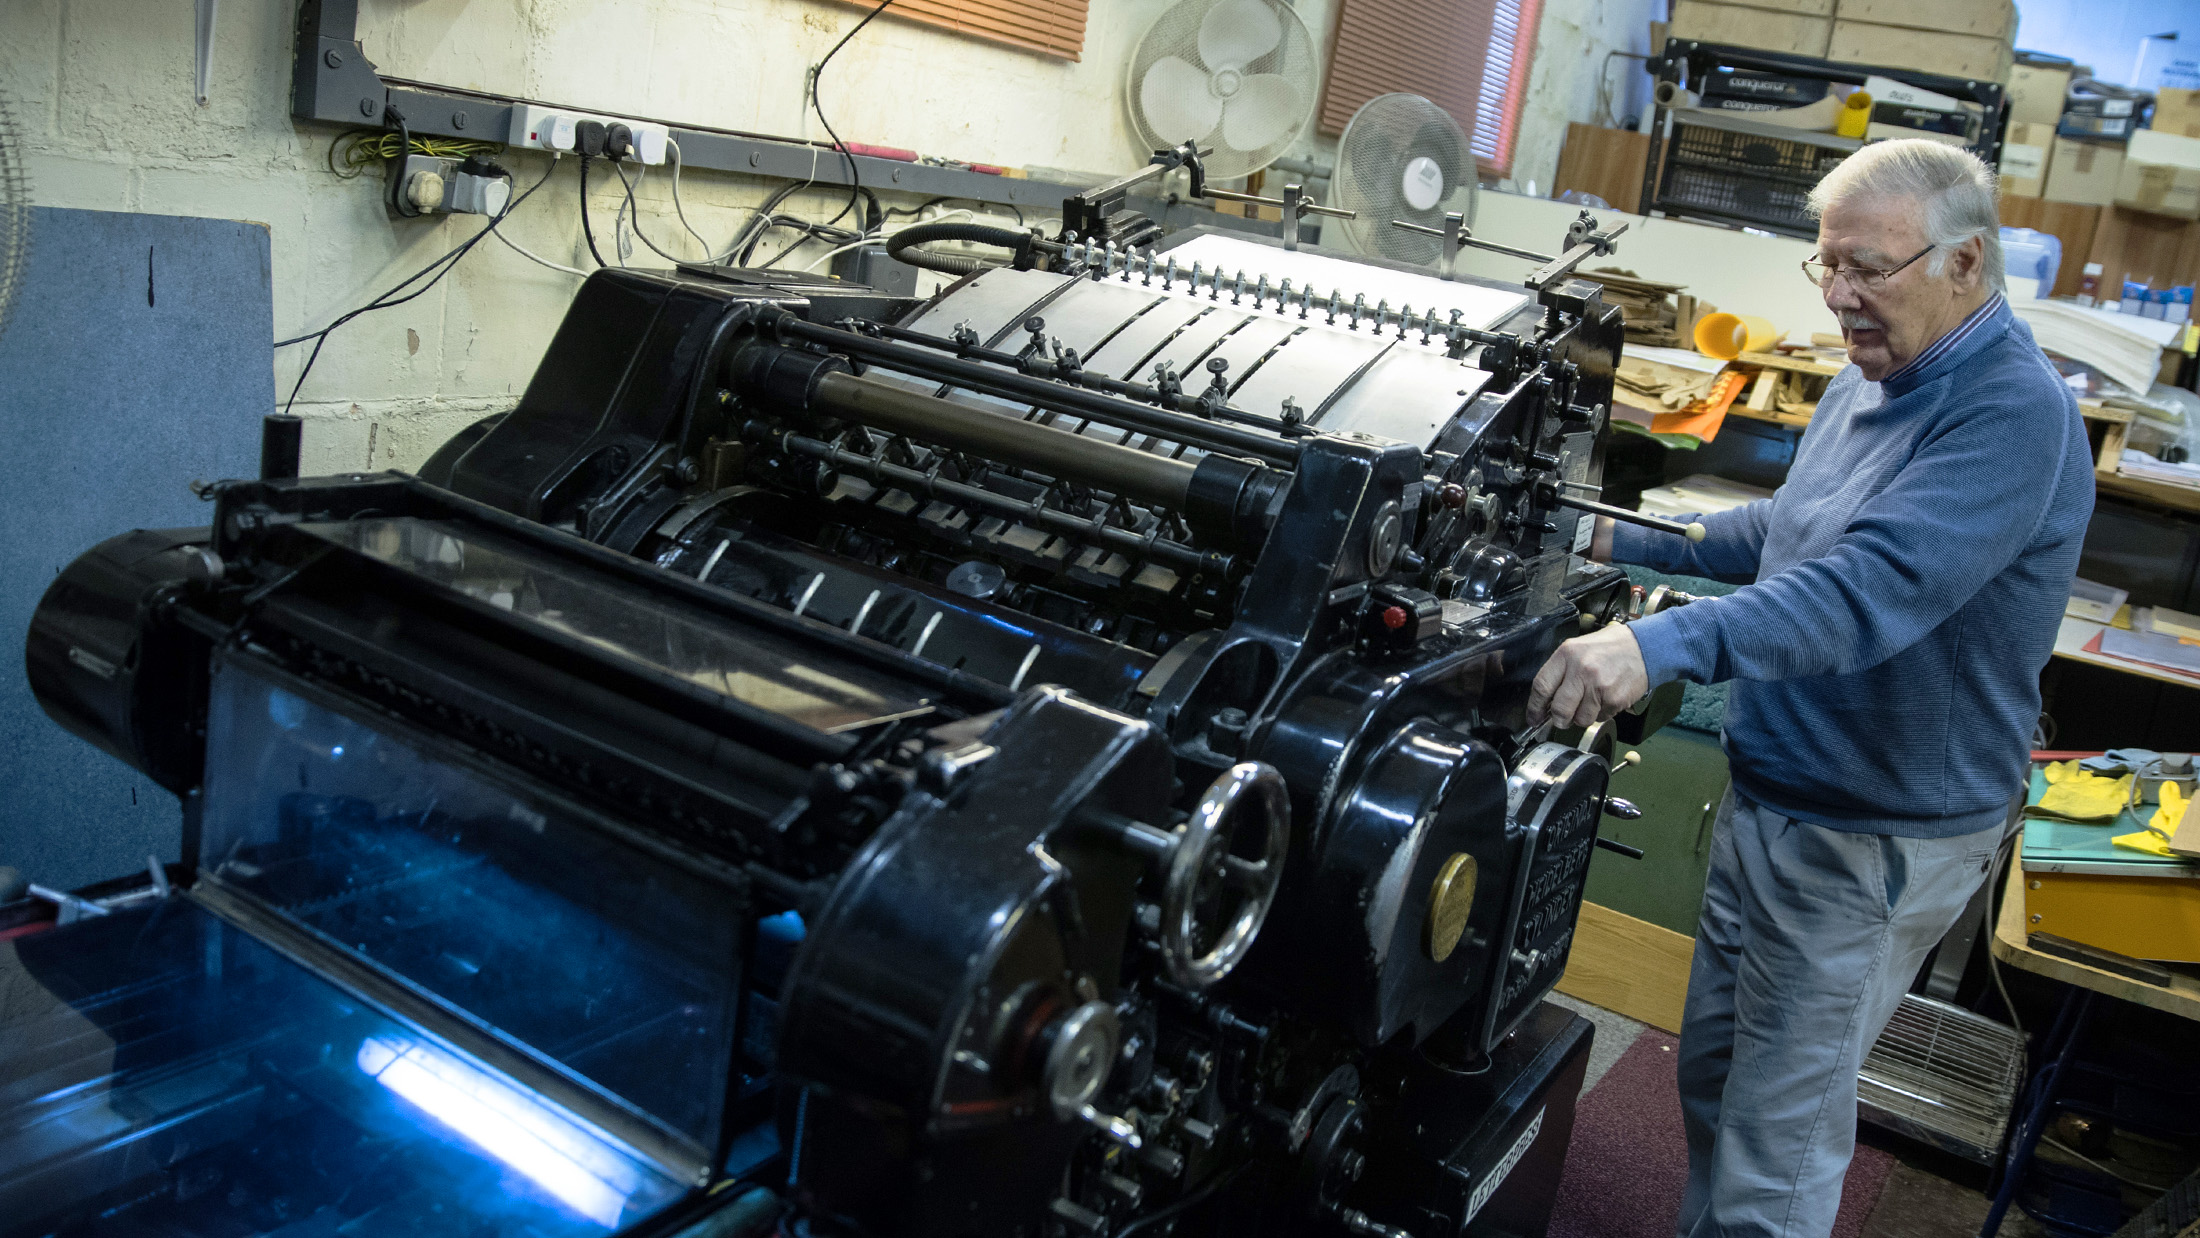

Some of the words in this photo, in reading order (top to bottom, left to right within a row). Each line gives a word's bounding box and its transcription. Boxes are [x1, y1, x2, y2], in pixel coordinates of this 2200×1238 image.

[1729, 78, 1787, 92] conqueror
[1507, 786, 1519, 801] STOP
[1546, 799, 1592, 852] ORIGINAL
[1527, 838, 1590, 912] HEIDELBERG
[1523, 883, 1576, 949] CYLINDER
[1470, 1114, 1542, 1217] LETTERPRESS
